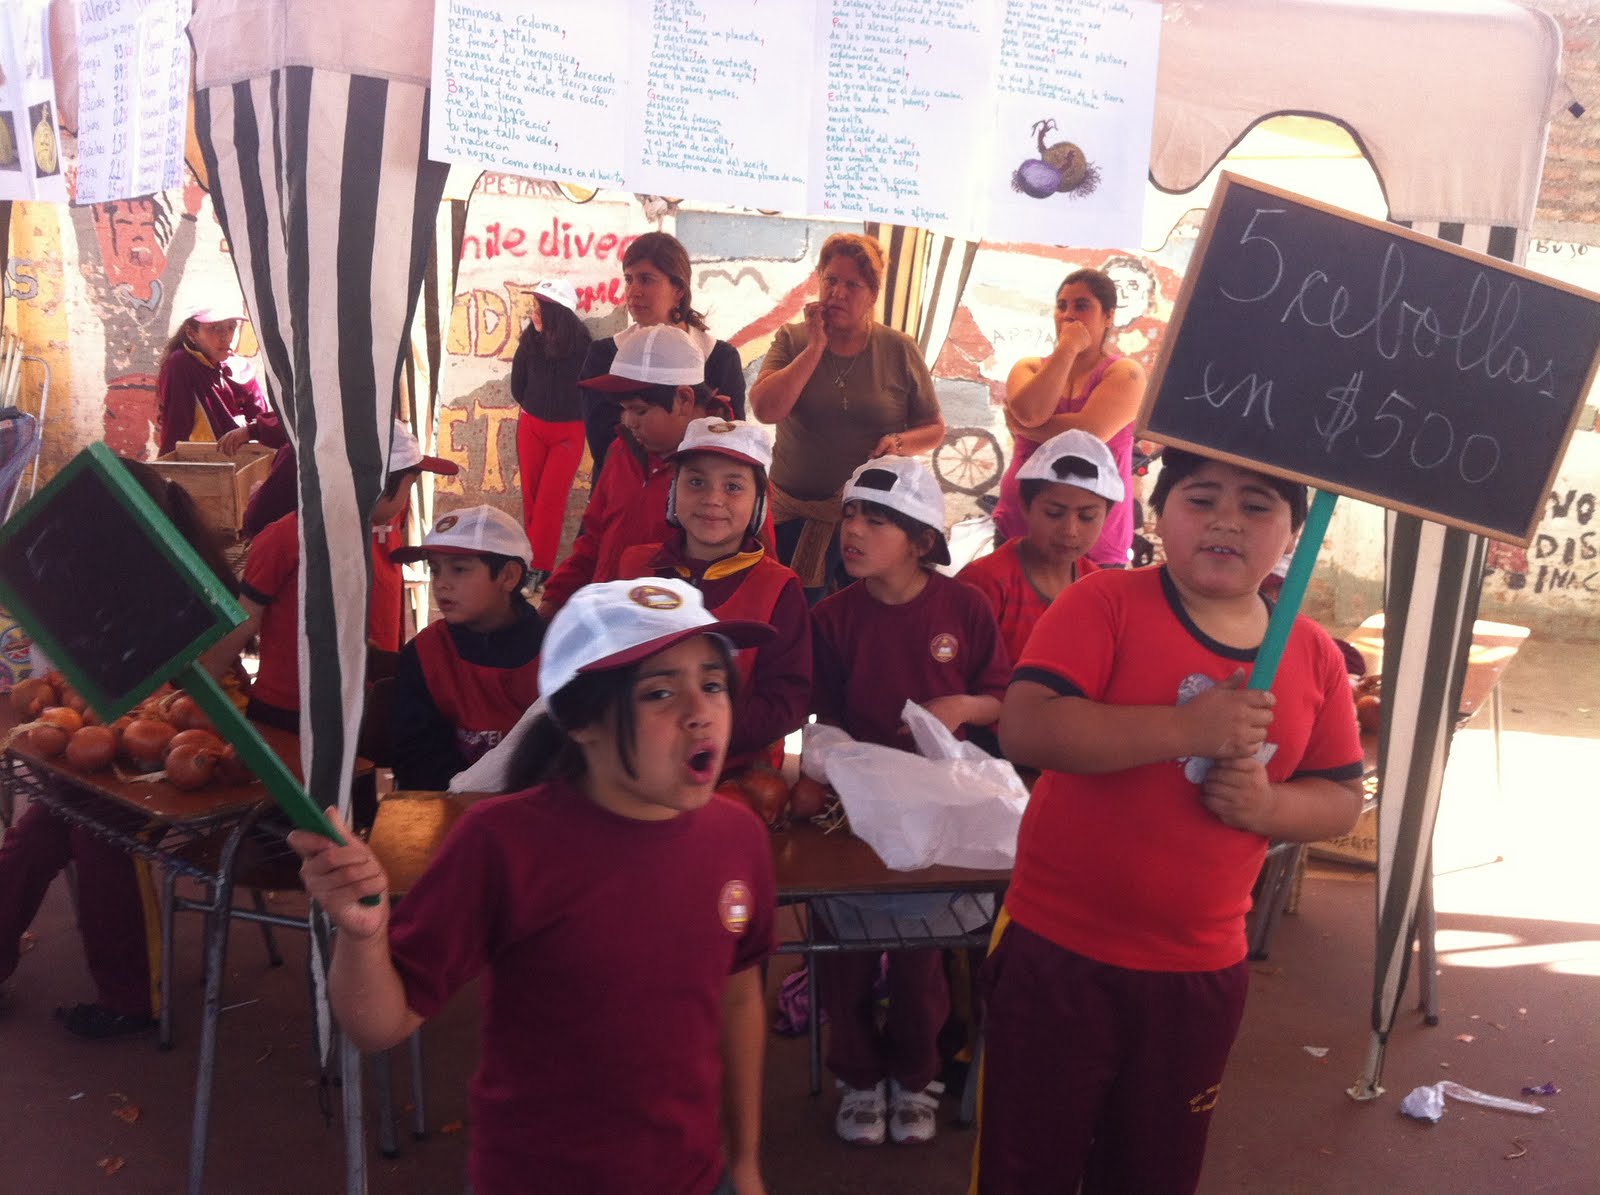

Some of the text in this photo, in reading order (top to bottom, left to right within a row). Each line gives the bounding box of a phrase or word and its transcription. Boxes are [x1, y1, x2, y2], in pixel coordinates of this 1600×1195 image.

[515, 13, 566, 40] redoma,
[726, 26, 765, 47] planeta,
[467, 33, 498, 49] formó
[503, 43, 515, 54] tu
[523, 44, 580, 71] hermosura,
[499, 51, 511, 65] de
[515, 58, 552, 72] cristal
[470, 60, 479, 71] el
[483, 64, 521, 79] secreto
[527, 70, 538, 83] de
[557, 76, 588, 91] tierra
[685, 74, 706, 84] mesa
[716, 66, 726, 77] de
[447, 78, 524, 105] Bajo la tierra
[506, 79, 518, 91] tu
[562, 90, 575, 101] de
[647, 88, 689, 105] Generosa
[446, 94, 526, 119] fue el milagro
[457, 107, 493, 121] cuando
[498, 114, 551, 134] apareció
[460, 134, 510, 152] nacieron
[463, 119, 489, 138] torpe
[494, 125, 521, 141] tallo
[525, 133, 559, 152] verde,
[690, 142, 700, 152] de
[444, 145, 462, 157] tus
[502, 157, 529, 169] como
[532, 159, 573, 176] espadas
[576, 169, 586, 178] en
[643, 145, 653, 155] al
[726, 157, 739, 167] del
[641, 157, 652, 166] se
[712, 165, 722, 175] en
[727, 167, 756, 179] rizada
[1219, 208, 1556, 400] 5 cebollas
[1184, 361, 1501, 484] en $500
